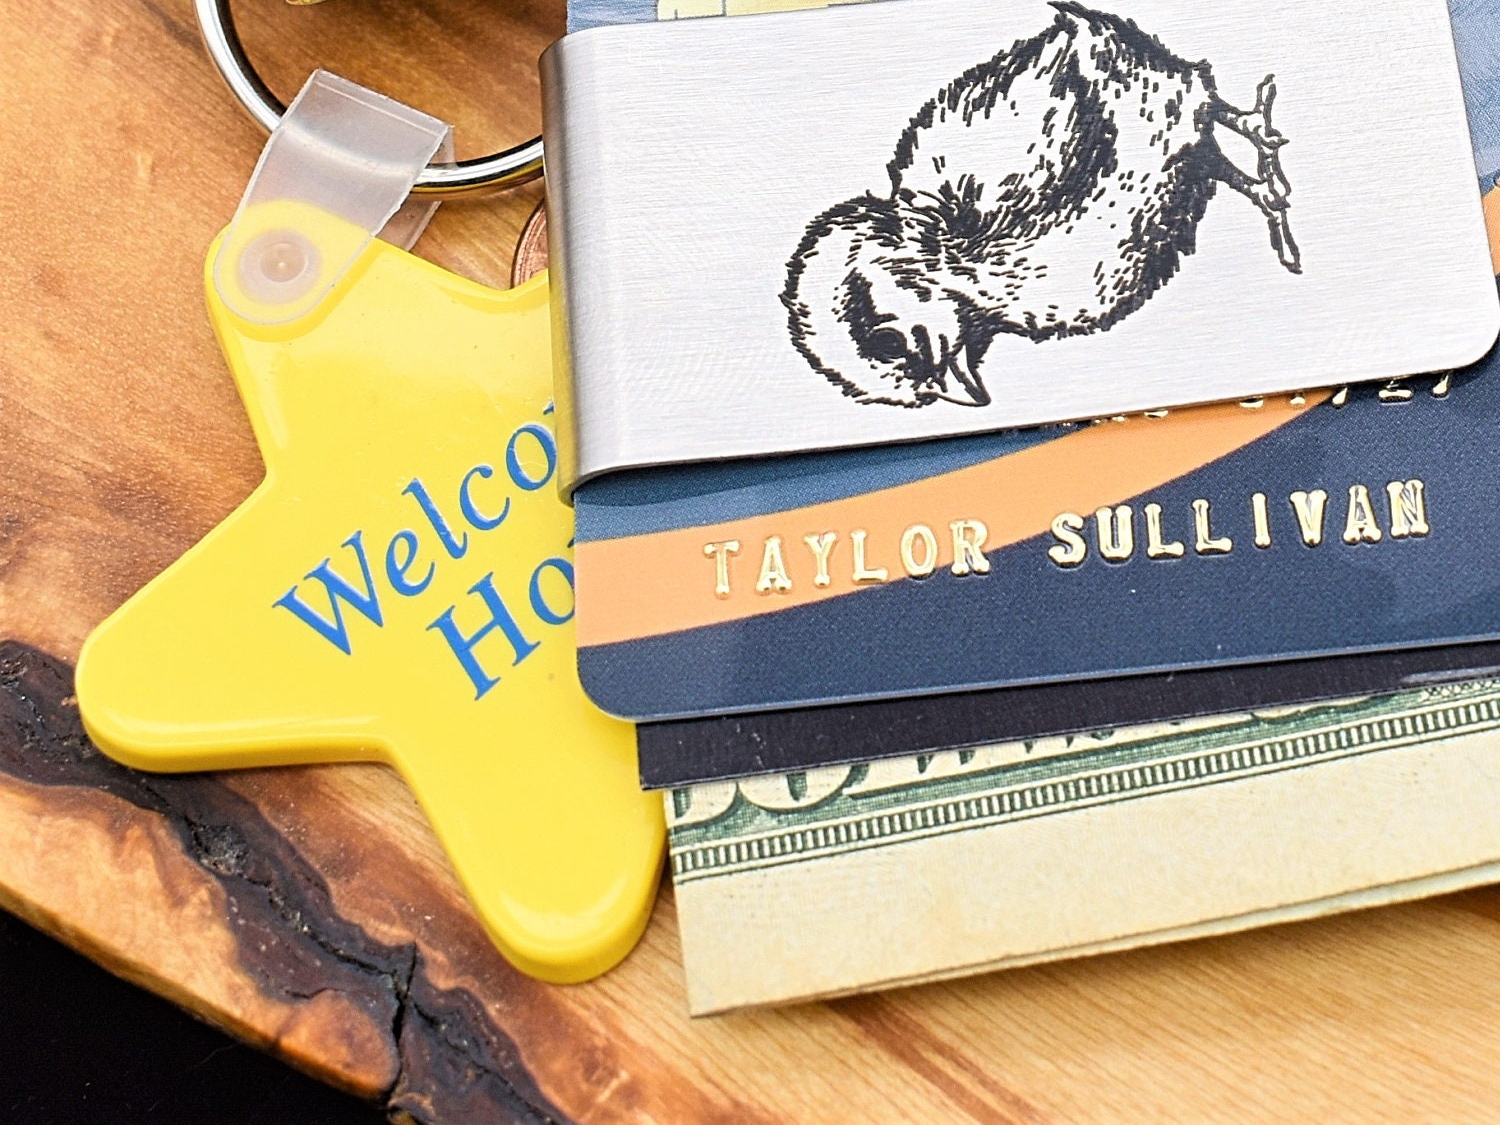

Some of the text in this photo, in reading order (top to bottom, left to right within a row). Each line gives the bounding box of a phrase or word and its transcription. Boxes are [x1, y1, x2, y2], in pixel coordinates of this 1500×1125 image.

[272, 400, 556, 656] Welco
[702, 478, 1430, 598] TAYLOR SULLIVAN
[426, 537, 576, 701] Ho
